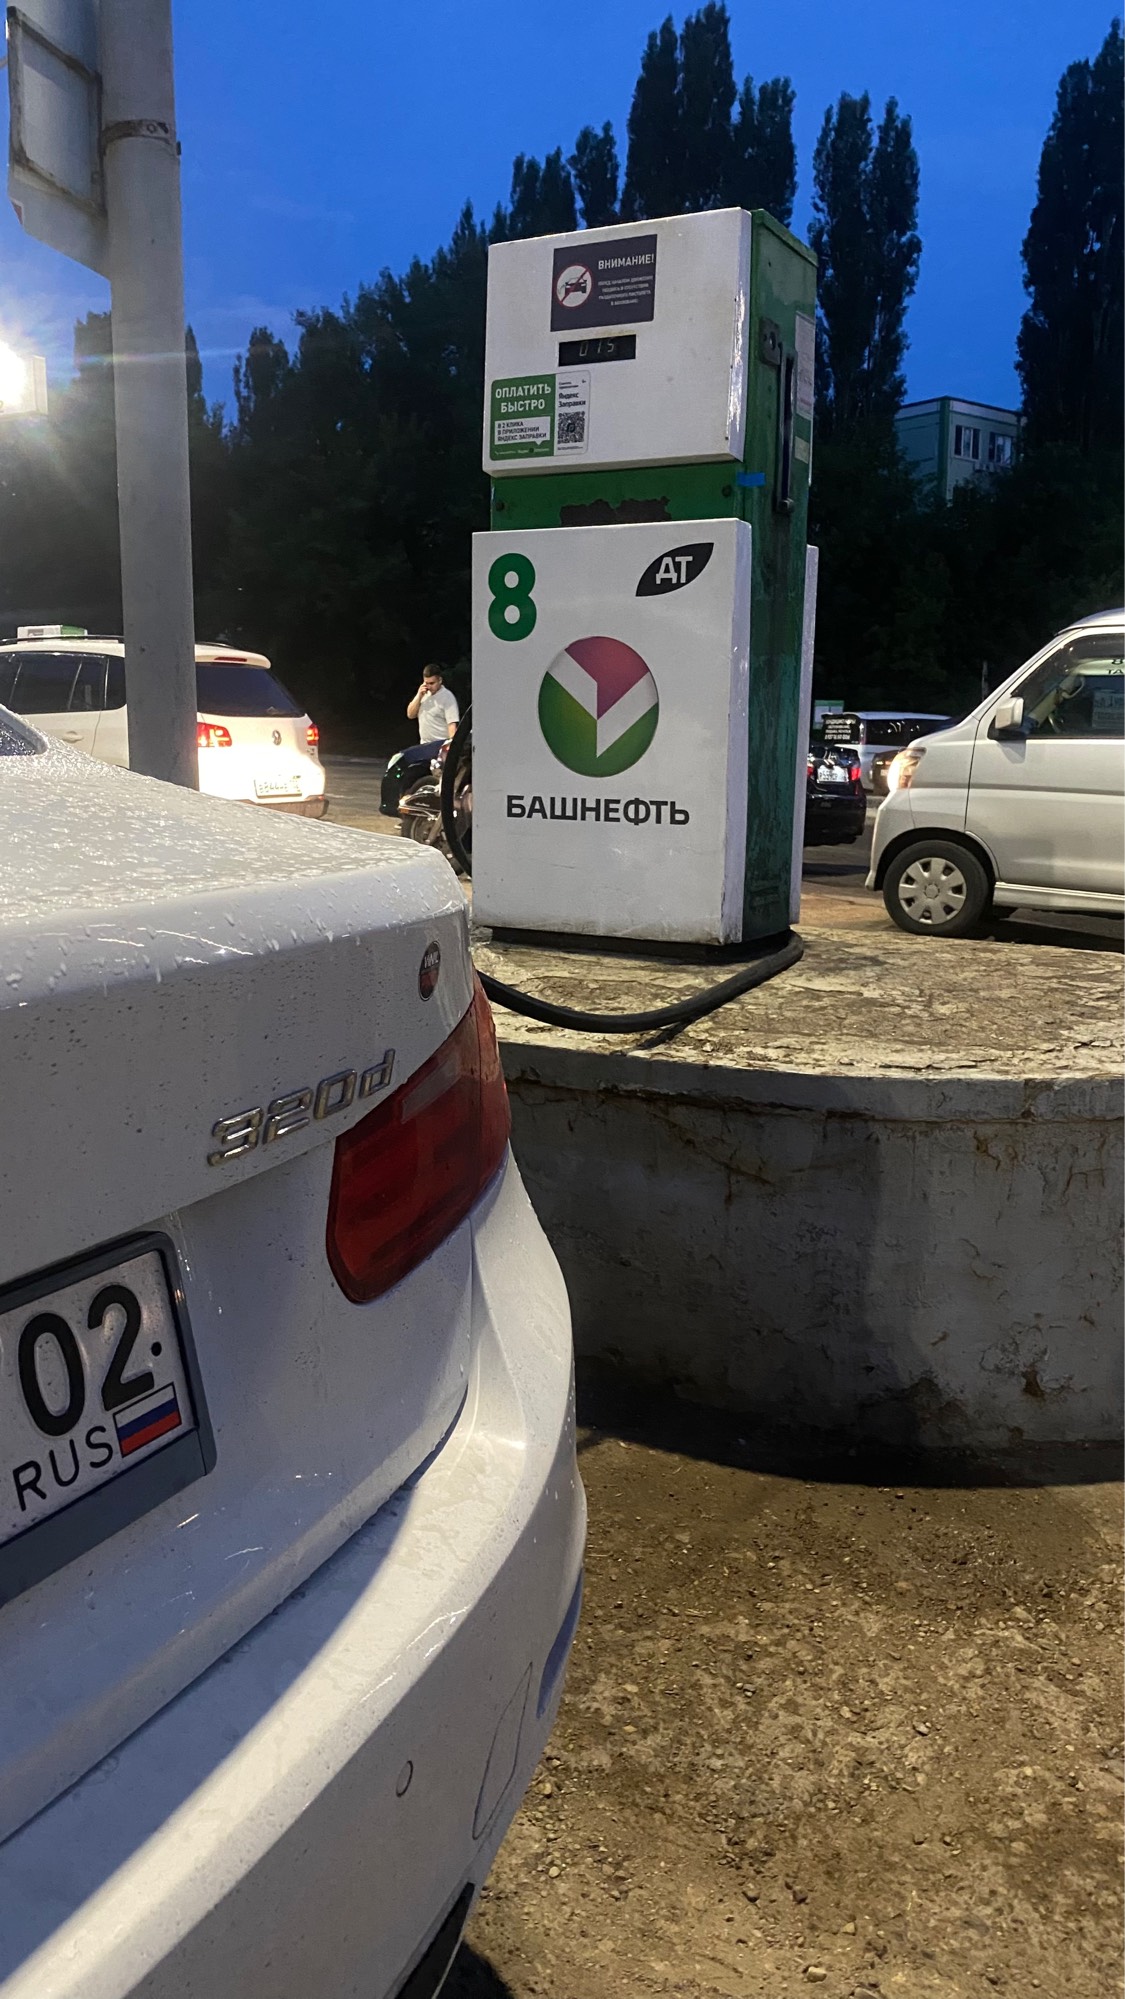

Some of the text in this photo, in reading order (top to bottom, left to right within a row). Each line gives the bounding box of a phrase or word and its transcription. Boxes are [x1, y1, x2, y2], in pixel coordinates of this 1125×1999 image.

[598, 253, 655, 270] ВНИМАНИЕ!
[495, 384, 552, 399] ОПЛАТИТЬ
[501, 399, 545, 413] БЫСТРО
[502, 426, 540, 435] ПРИЛОЖЕНИИ
[519, 432, 547, 440] ЗАПРАВКИ
[655, 555, 693, 584] ДТ
[488, 553, 537, 642] 8
[506, 795, 690, 825] БАШНЕФТЬ
[206, 1048, 396, 1167] 320d
[12, 1426, 114, 1512] RUS
